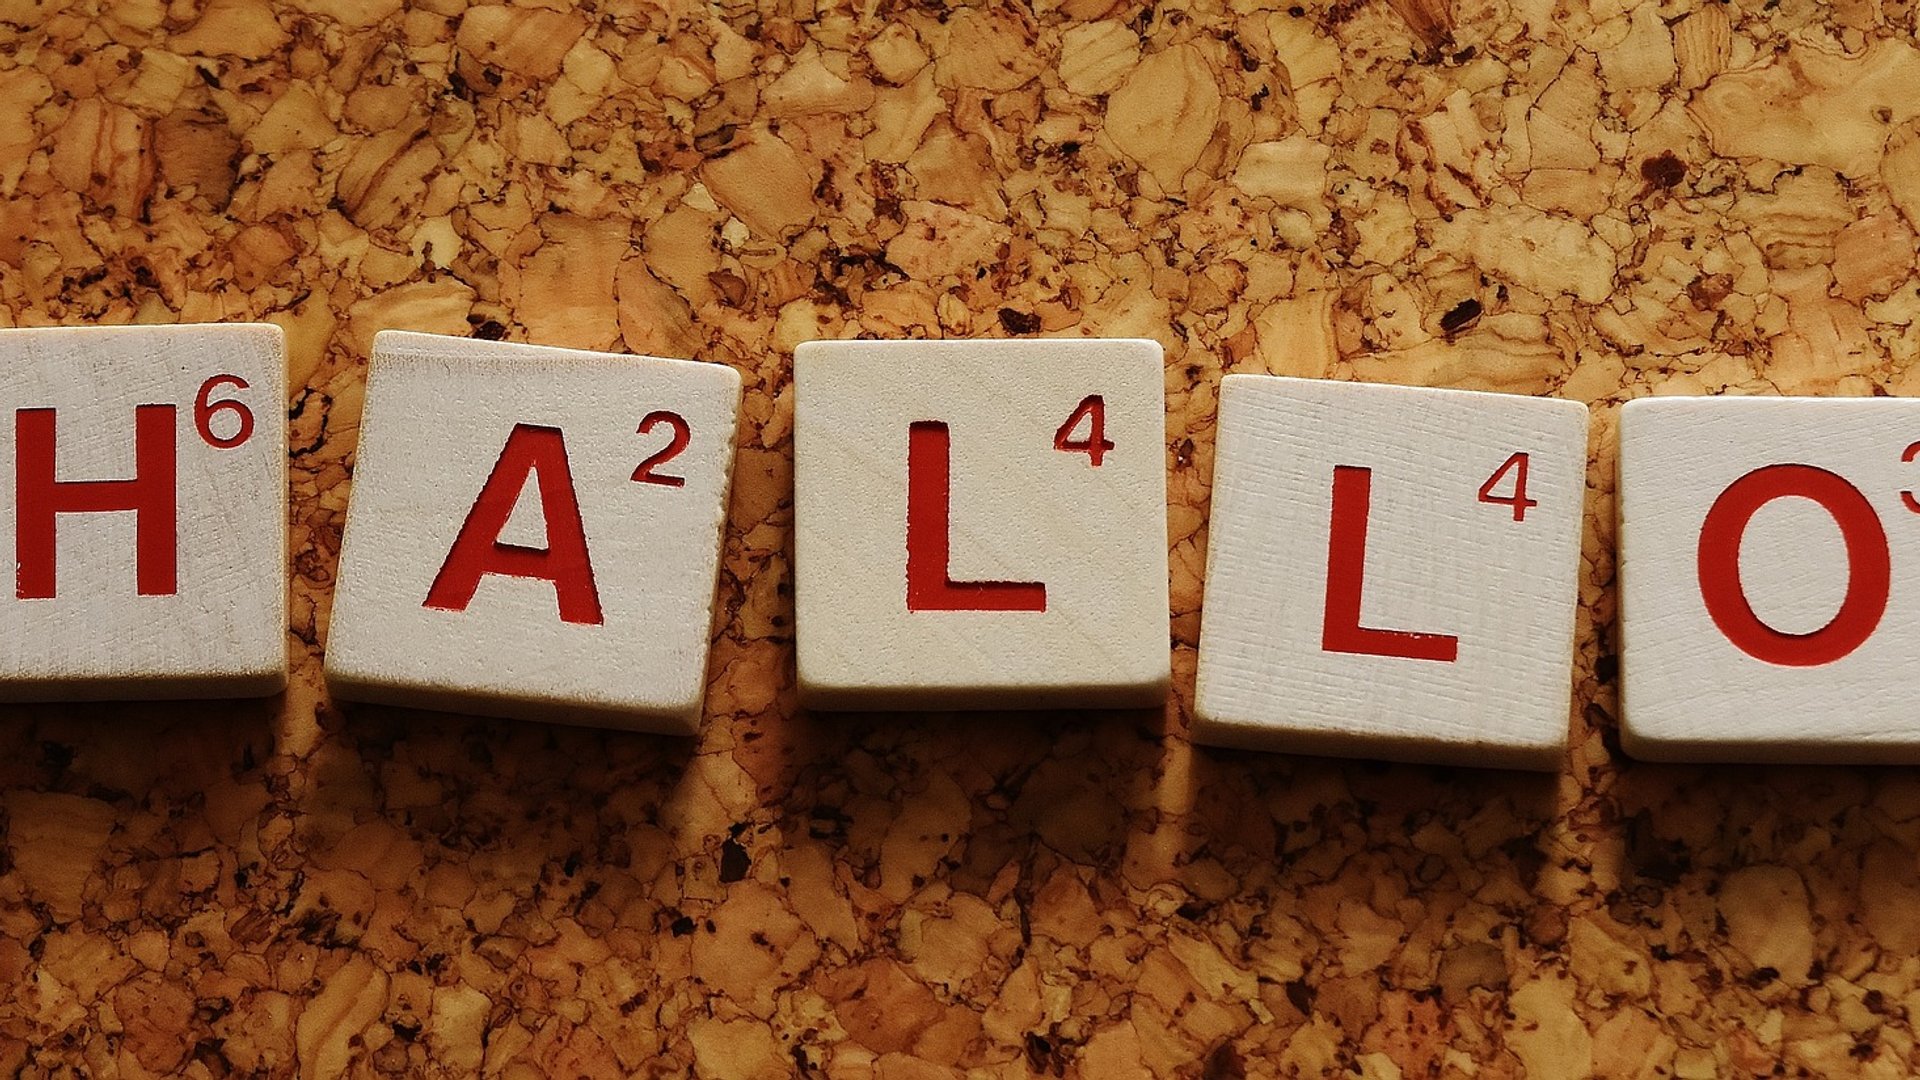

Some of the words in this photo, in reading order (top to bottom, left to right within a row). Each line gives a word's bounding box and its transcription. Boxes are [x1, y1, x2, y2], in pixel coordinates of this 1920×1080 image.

[15, 404, 177, 600] H
[194, 374, 254, 449] 6
[631, 412, 691, 487] 2
[1054, 394, 1114, 468] 4
[1478, 450, 1536, 521] 4
[423, 424, 604, 625] A
[906, 421, 1047, 613] L
[1321, 465, 1458, 662] L
[1697, 463, 1891, 667] O
